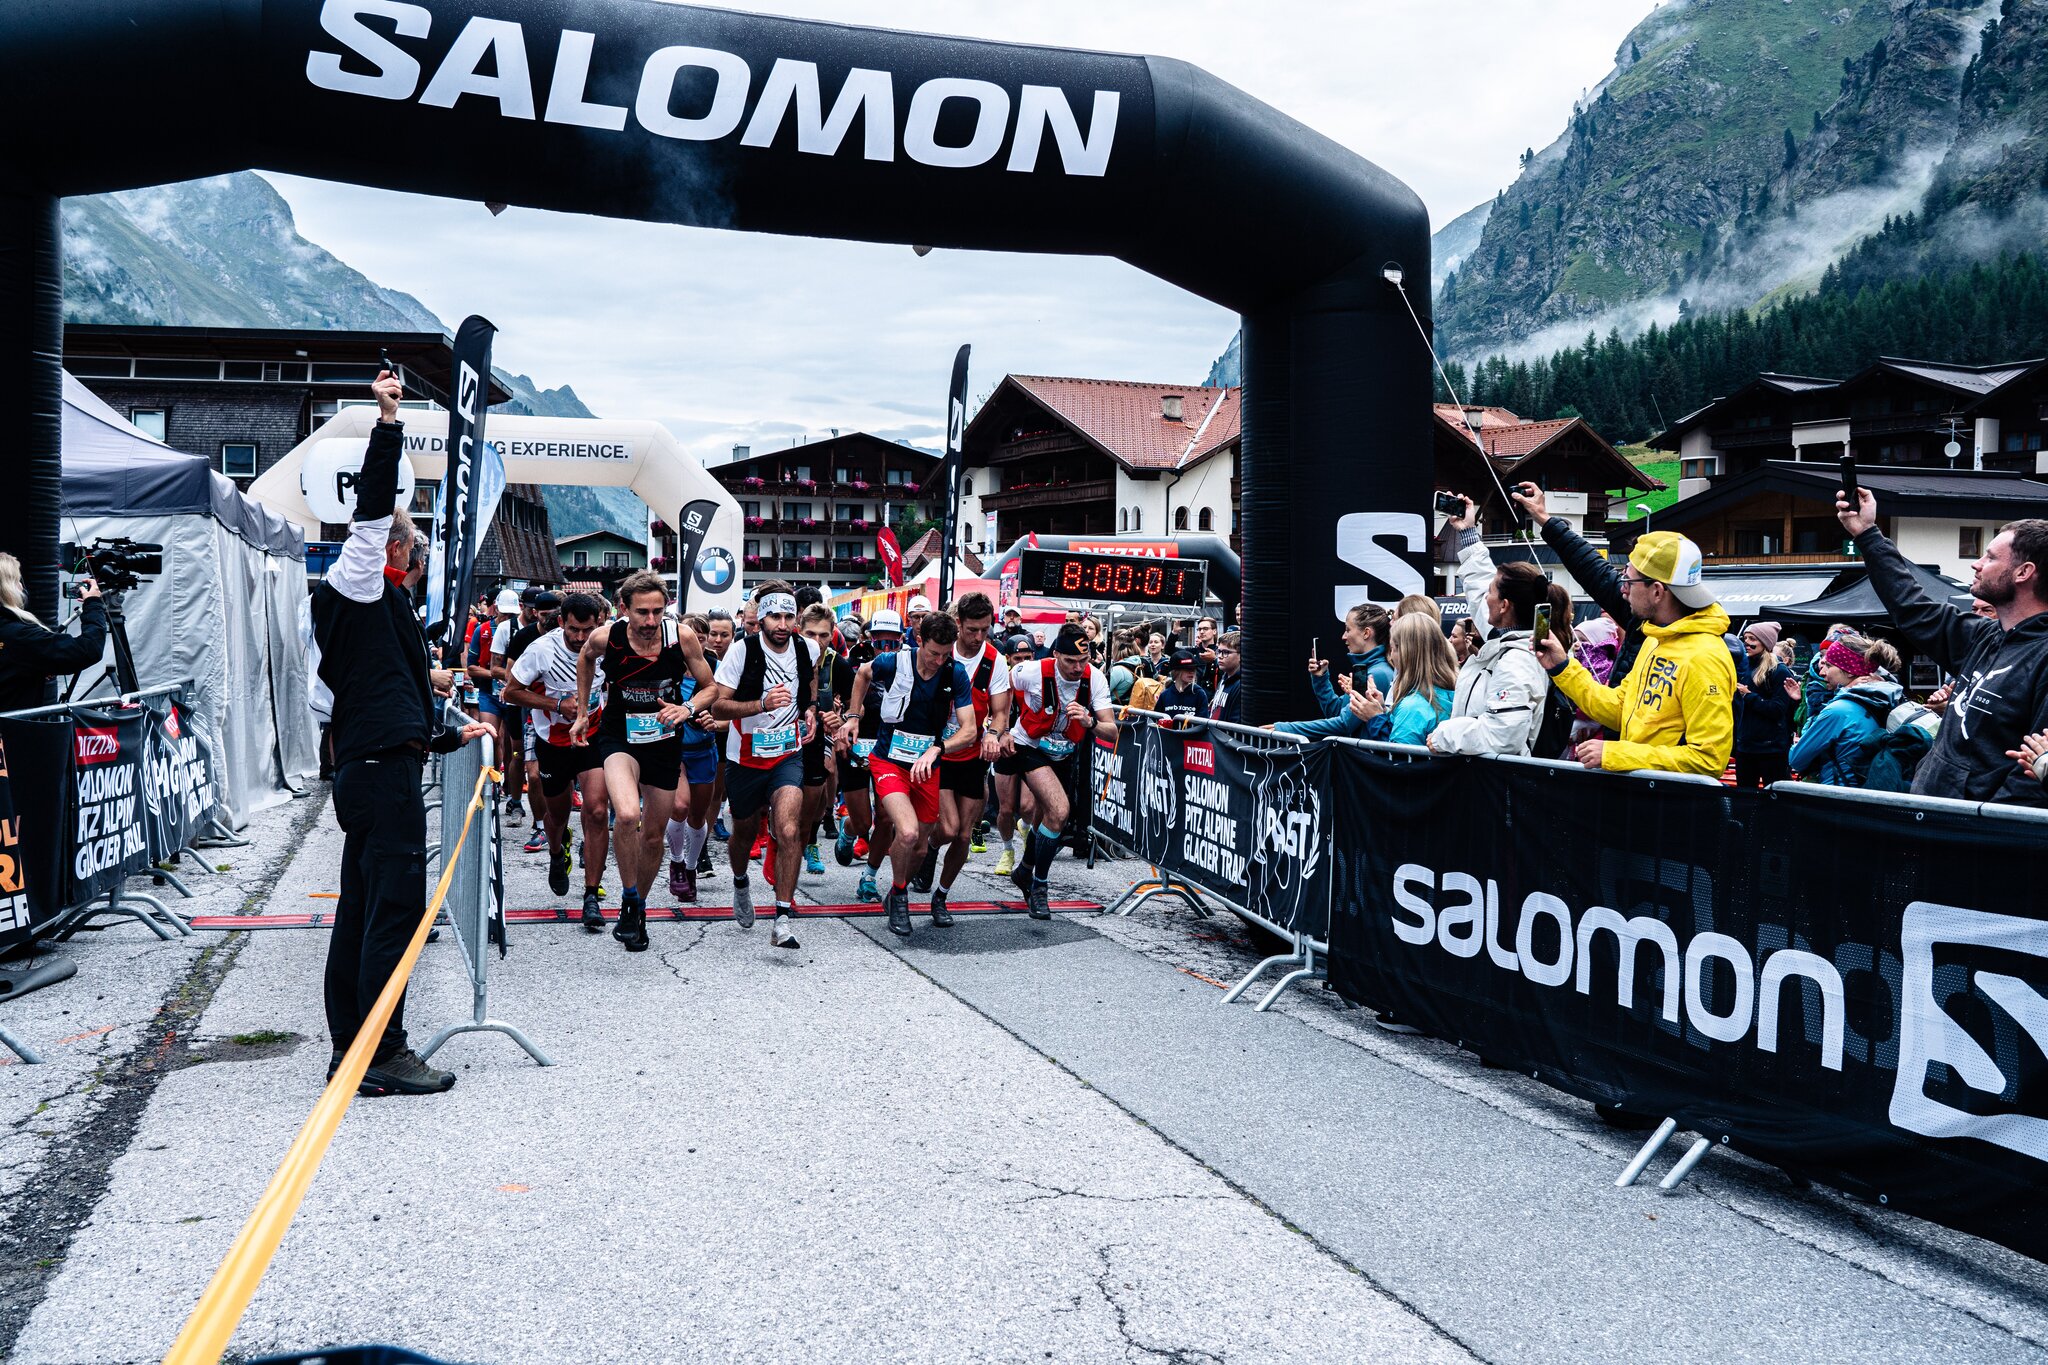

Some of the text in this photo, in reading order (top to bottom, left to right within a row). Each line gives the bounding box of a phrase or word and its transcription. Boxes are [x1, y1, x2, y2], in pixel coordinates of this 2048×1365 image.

[305, 0, 1121, 177] SALOMON
[512, 441, 629, 459] EXPERIENCE.
[697, 549, 733, 564] BMW
[1063, 562, 1184, 595] 8:00:01
[622, 690, 656, 703] WALKER
[1643, 690, 1662, 711] on
[1975, 695, 1990, 705] 2020
[638, 719, 661, 727] 327
[764, 731, 786, 742] 3265
[902, 738, 925, 748] 3312
[1186, 746, 1213, 768] PITZTAL
[1185, 774, 1229, 814] SALOMON
[1184, 804, 1237, 850] PITZ ALPINE
[75, 834, 121, 881] GLACIER
[1183, 833, 1248, 887] GLACIER TRAIL
[1392, 862, 1844, 1072] salomon
